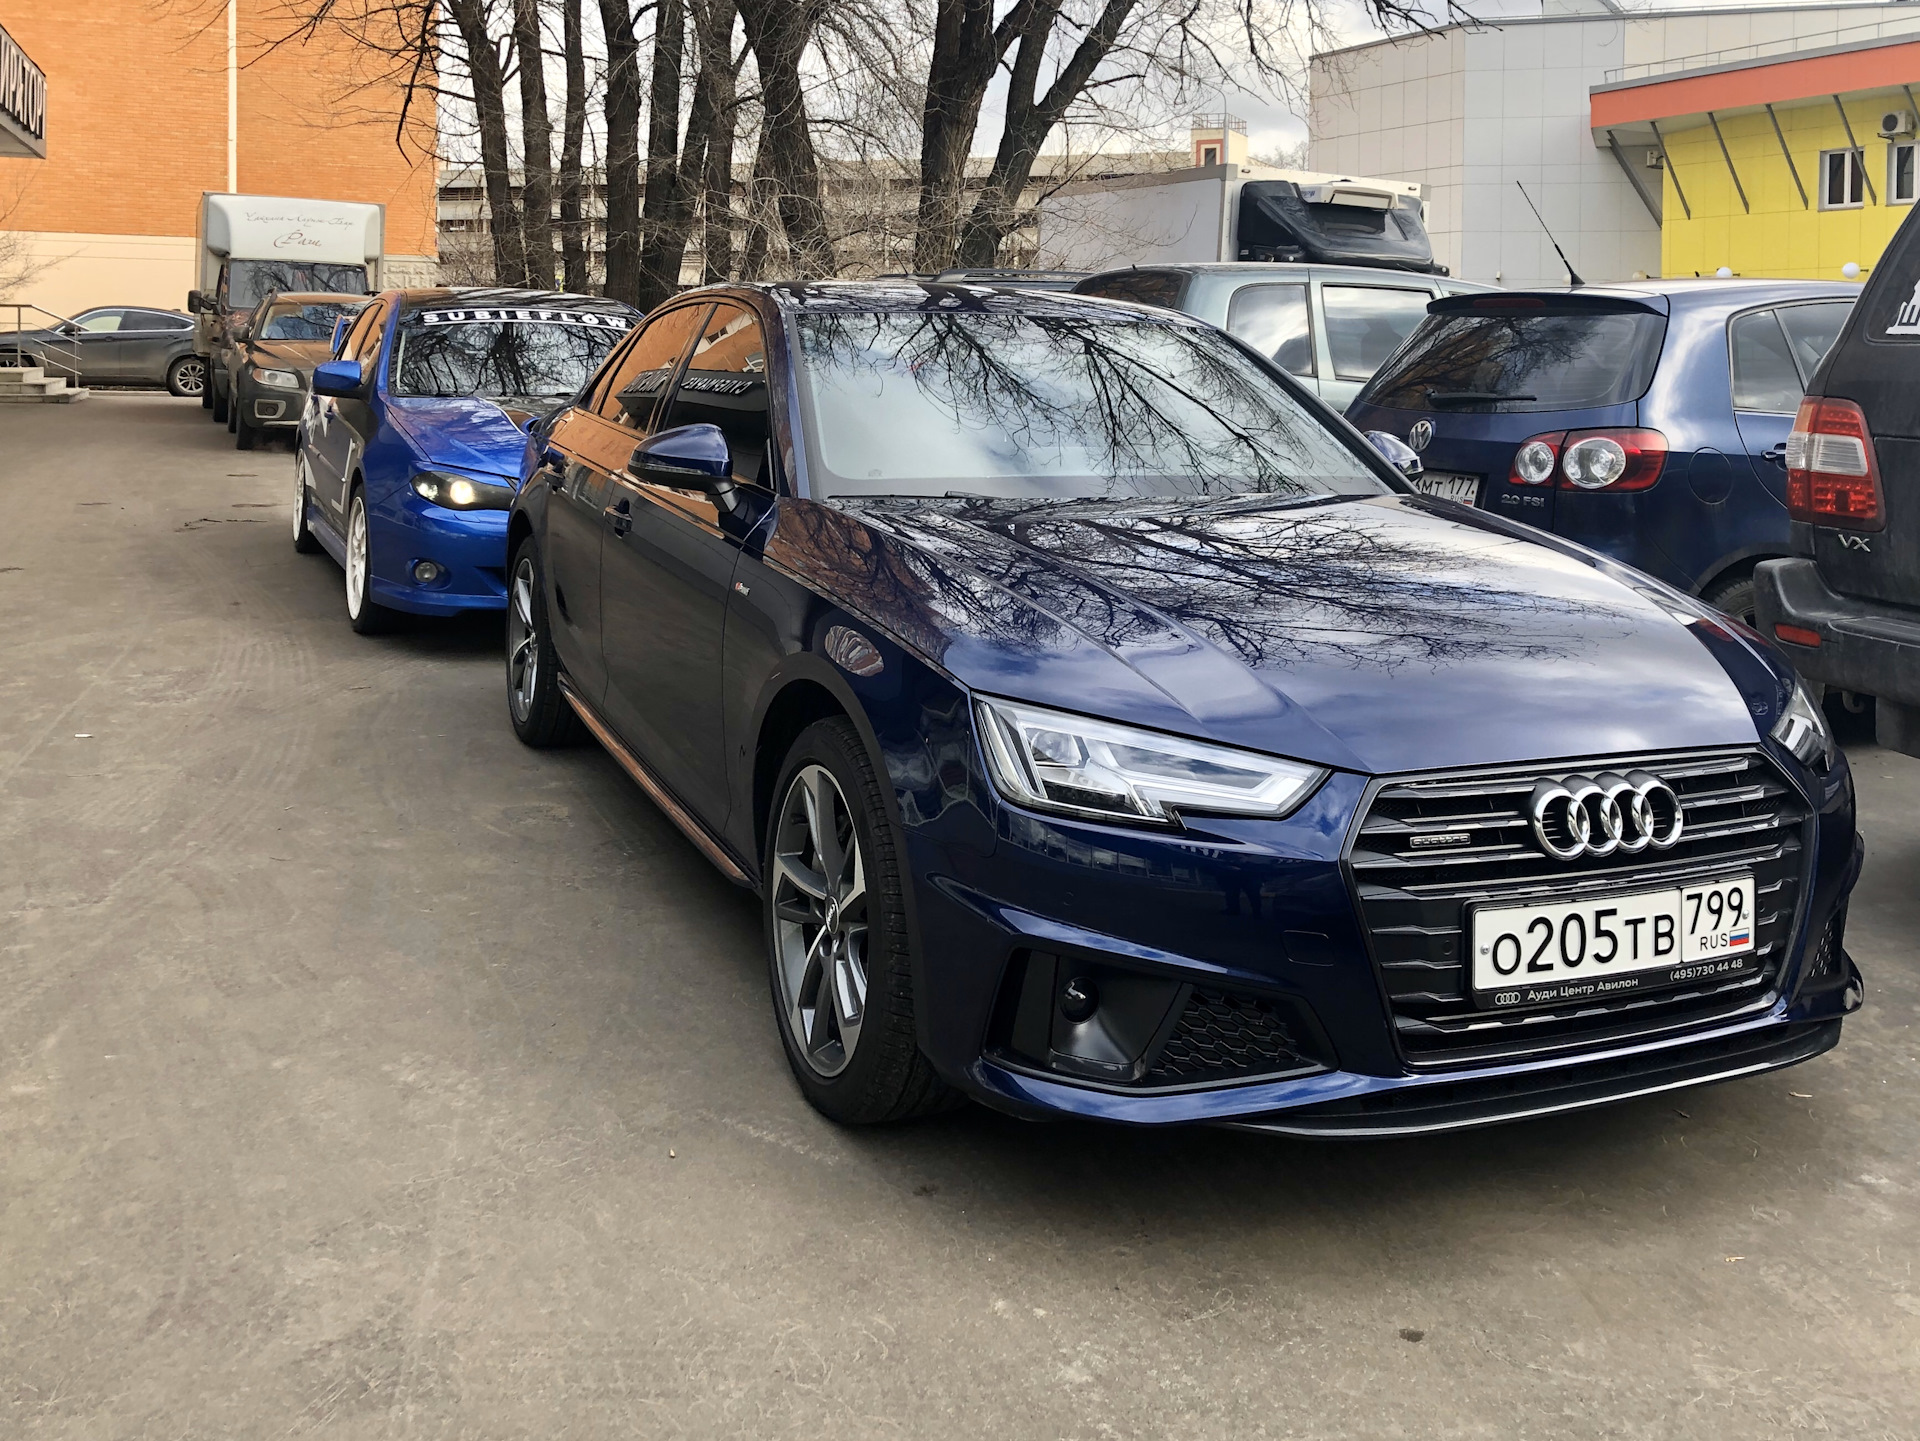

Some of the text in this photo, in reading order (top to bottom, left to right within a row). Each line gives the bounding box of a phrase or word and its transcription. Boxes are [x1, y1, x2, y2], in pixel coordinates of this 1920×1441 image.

[423, 310, 627, 328] SUBIEFLOW
[1448, 476, 1474, 496] 177
[1523, 496, 1545, 508] FSI
[1838, 534, 1871, 552] VX
[1412, 834, 1469, 846] quattro
[1686, 887, 1744, 935] 799
[1700, 933, 1729, 951] RUS
[1670, 958, 1743, 981] (495)730 44 48
[1527, 978, 1639, 1002] Ауди Центр Авилон
